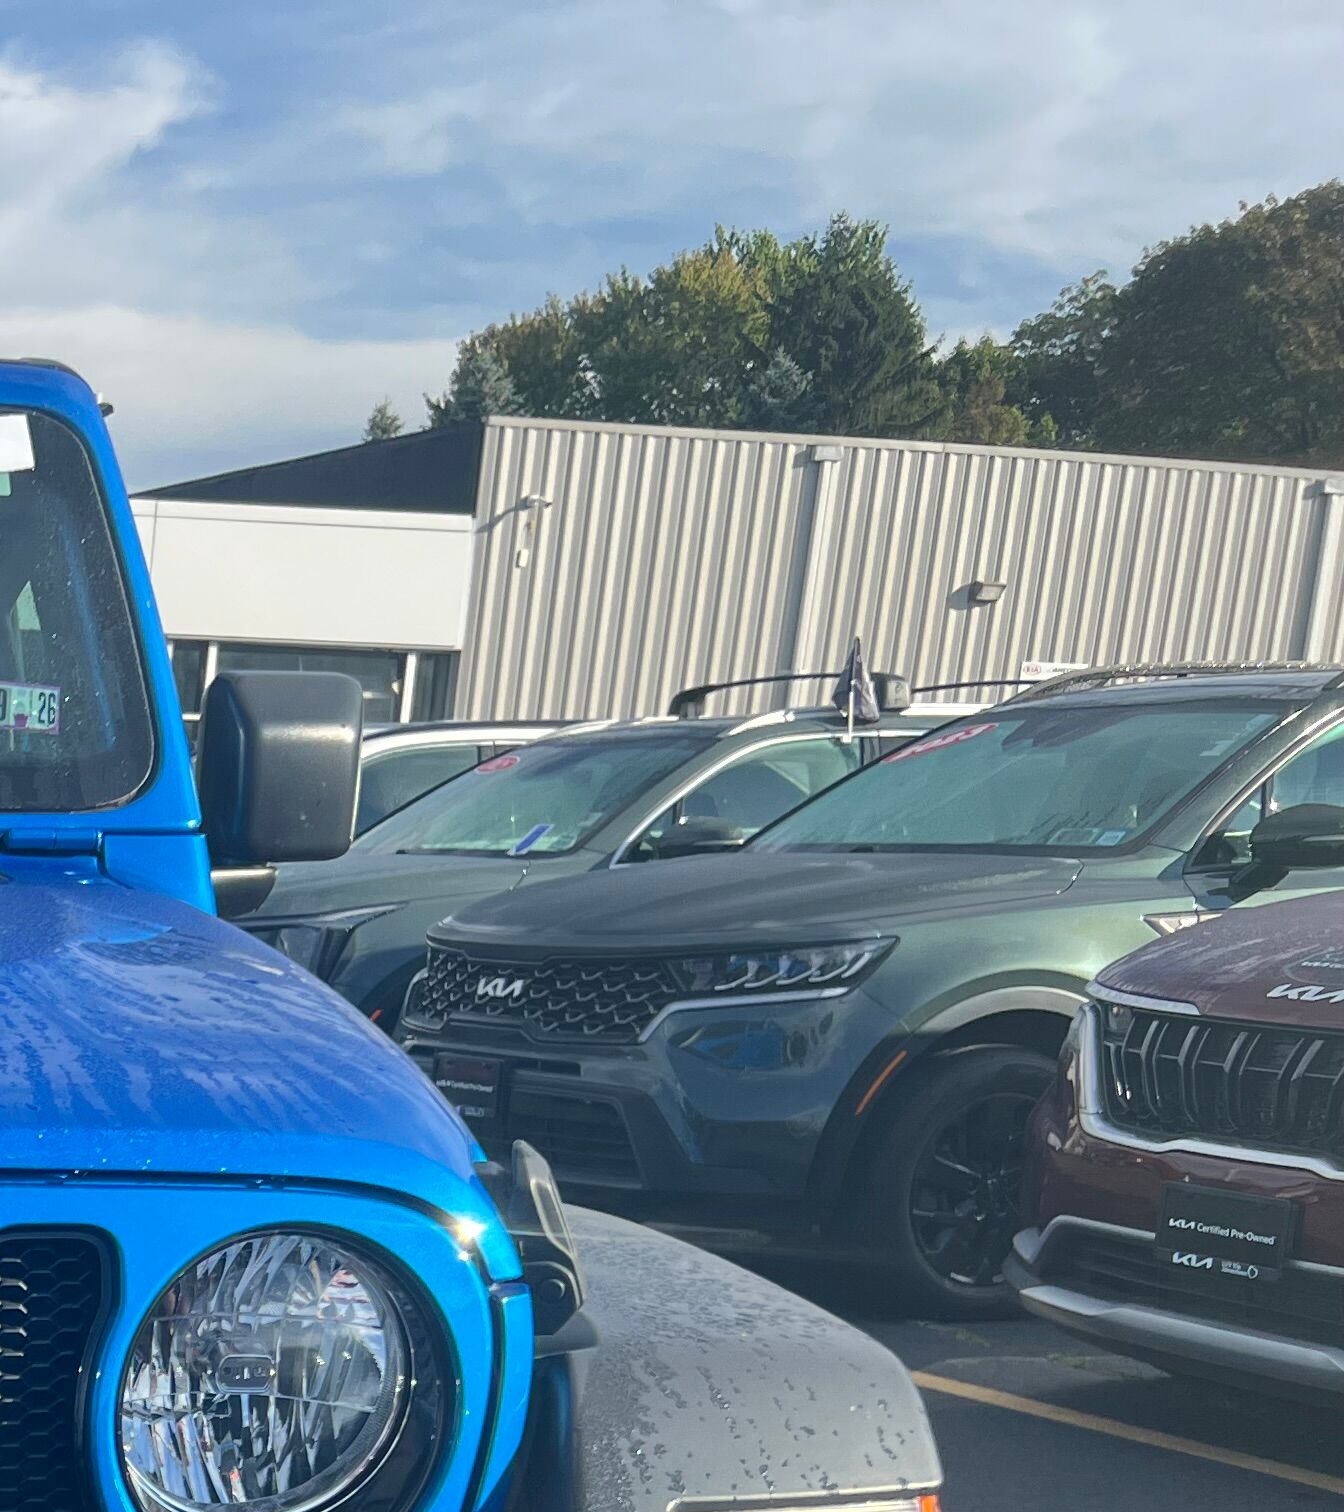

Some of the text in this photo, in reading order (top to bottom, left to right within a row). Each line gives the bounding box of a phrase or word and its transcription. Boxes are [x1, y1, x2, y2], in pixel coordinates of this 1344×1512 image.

[38, 692, 56, 724] 26
[477, 977, 526, 997] KIA
[1169, 1218, 1275, 1245] KIA Certified Pre-Owned
[1172, 1251, 1213, 1269] KIA
